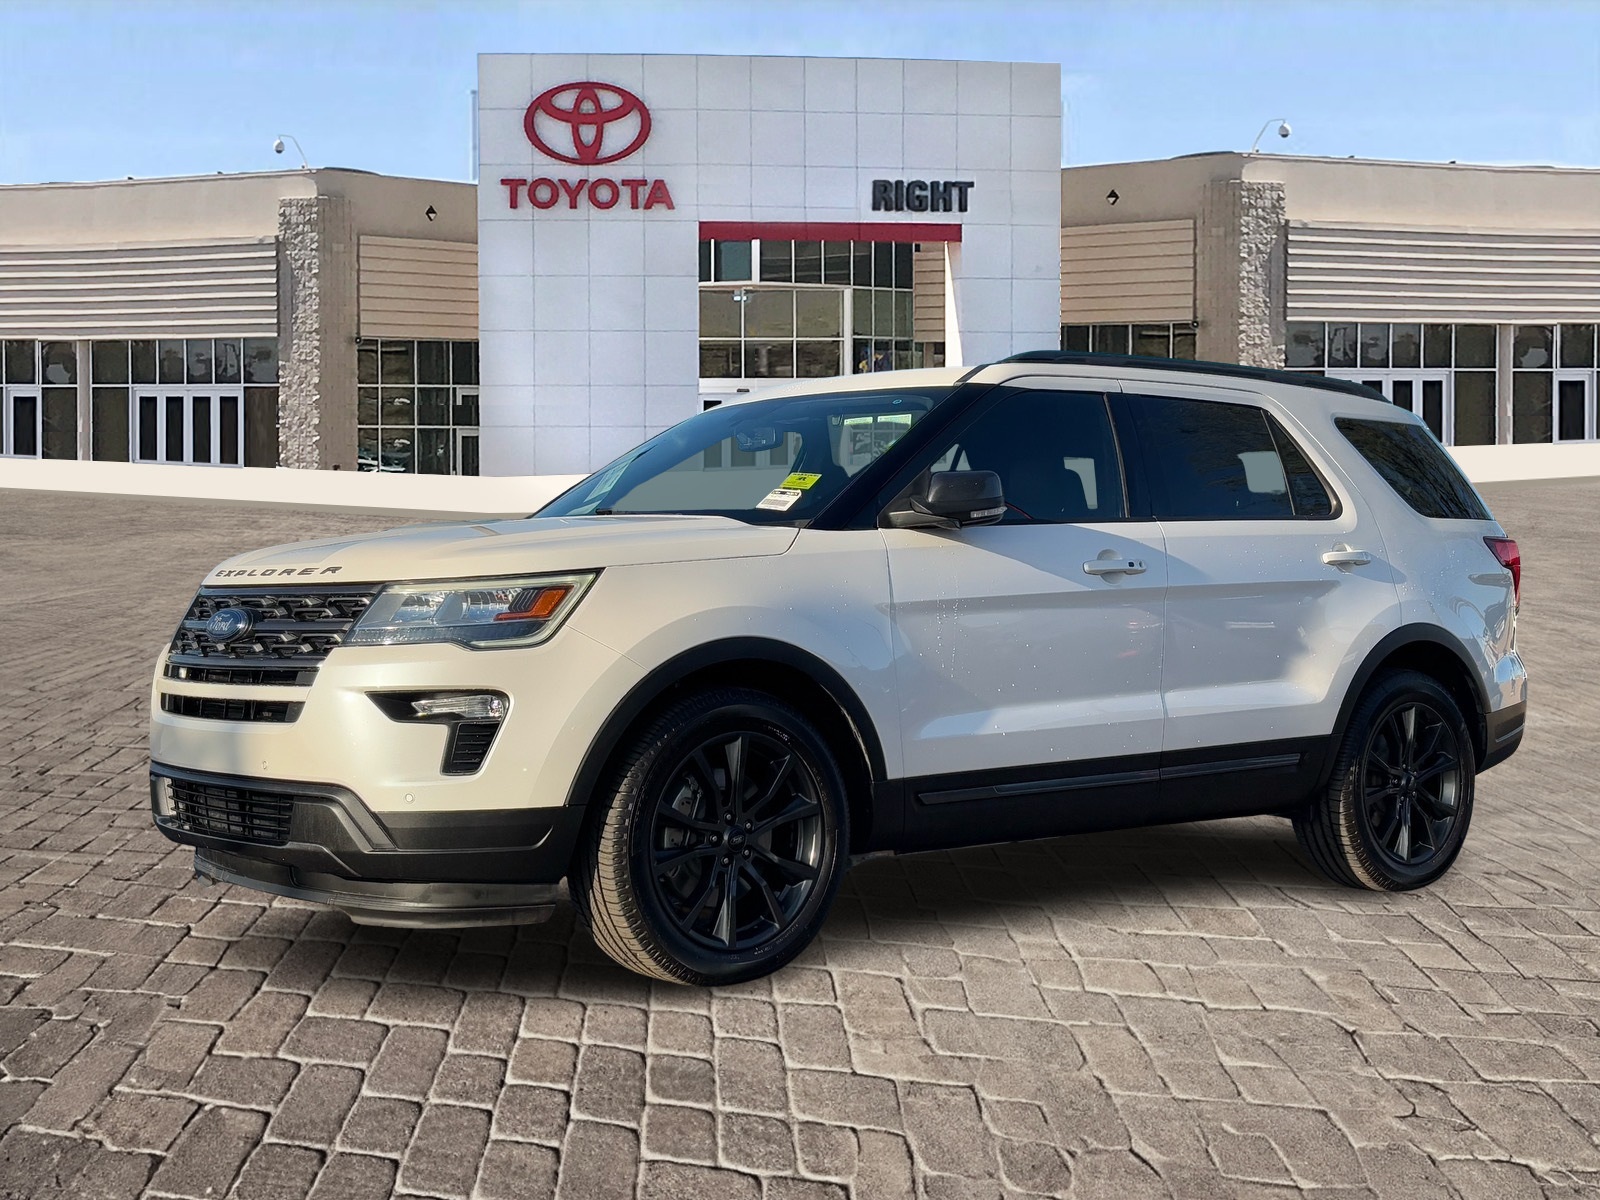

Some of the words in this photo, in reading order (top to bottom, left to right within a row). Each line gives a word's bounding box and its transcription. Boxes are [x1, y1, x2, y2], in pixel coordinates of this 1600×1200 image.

[501, 178, 675, 209] TOYOTA
[872, 179, 974, 212] RIGHT
[215, 566, 343, 577] EXPLORER
[210, 614, 233, 631] Ford
